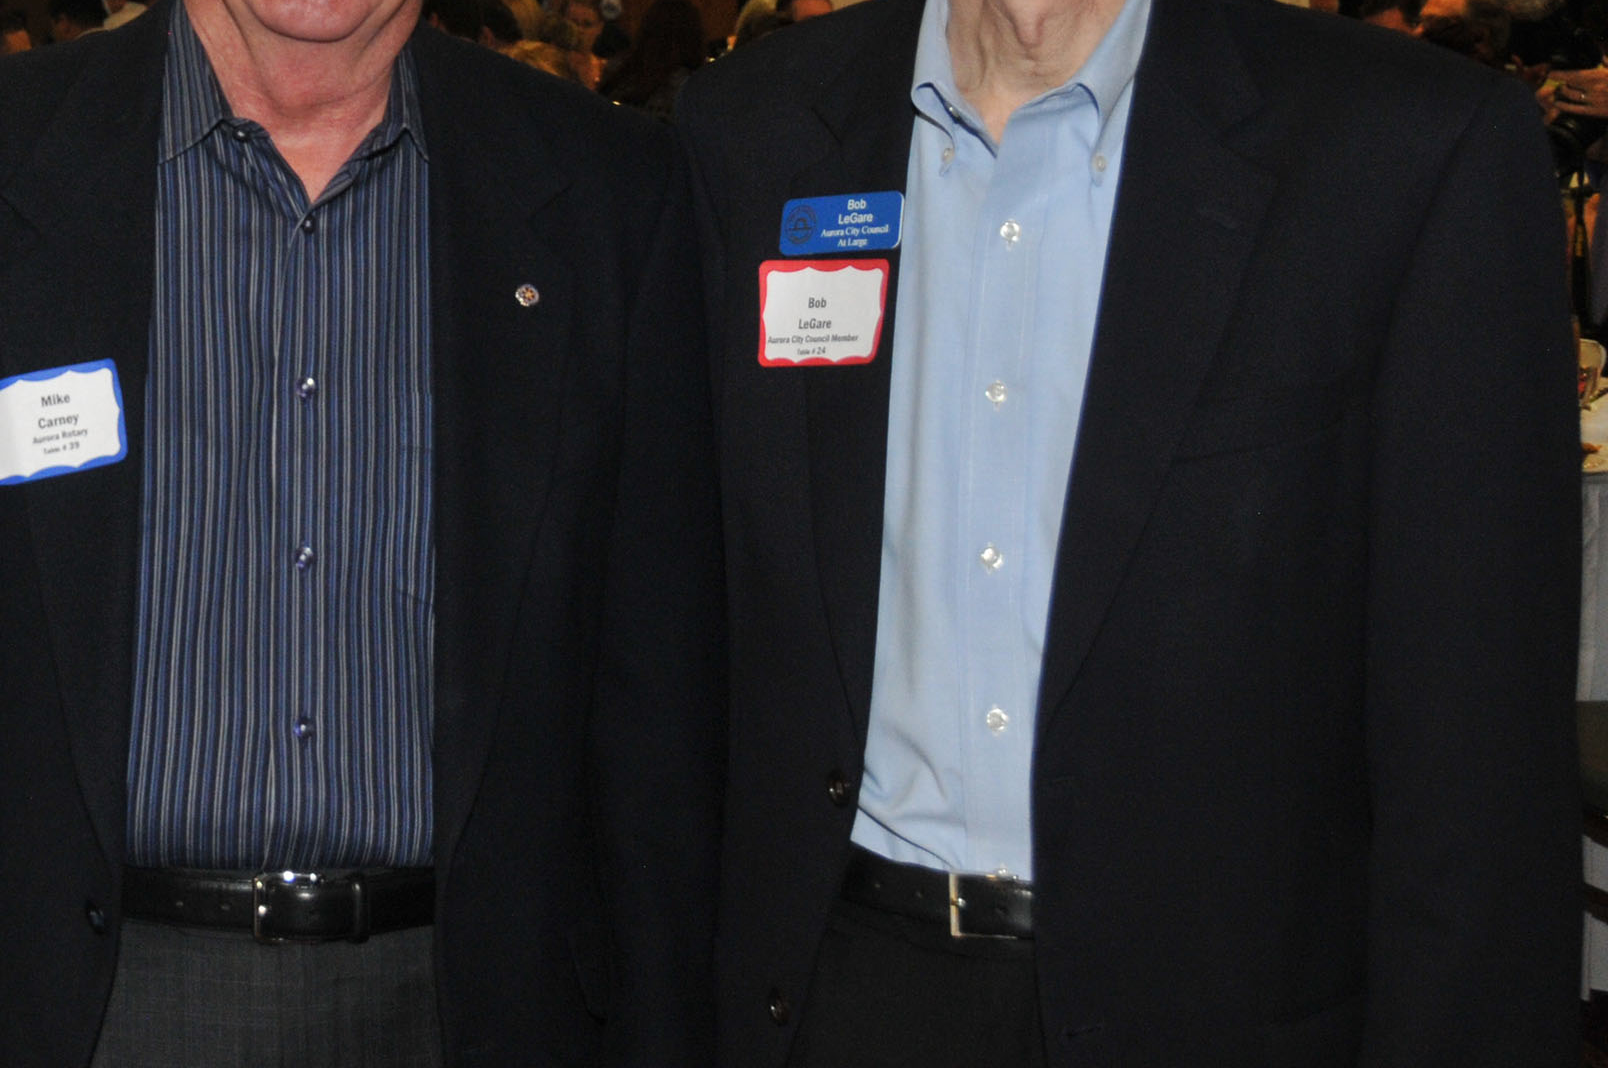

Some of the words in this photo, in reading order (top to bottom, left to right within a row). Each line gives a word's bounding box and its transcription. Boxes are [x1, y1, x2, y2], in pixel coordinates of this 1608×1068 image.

[847, 199, 867, 211] Bob
[838, 212, 874, 225] LeGare
[820, 229, 845, 237] Aurora
[845, 226, 861, 237] City
[861, 224, 890, 235] Council
[808, 297, 827, 309] Bob
[798, 318, 832, 330] LeGare
[768, 336, 790, 344] Aurora
[791, 334, 804, 344] City
[804, 334, 830, 343] Council
[831, 334, 859, 342] Member
[41, 394, 71, 407] Mike
[38, 414, 79, 429] Carney
